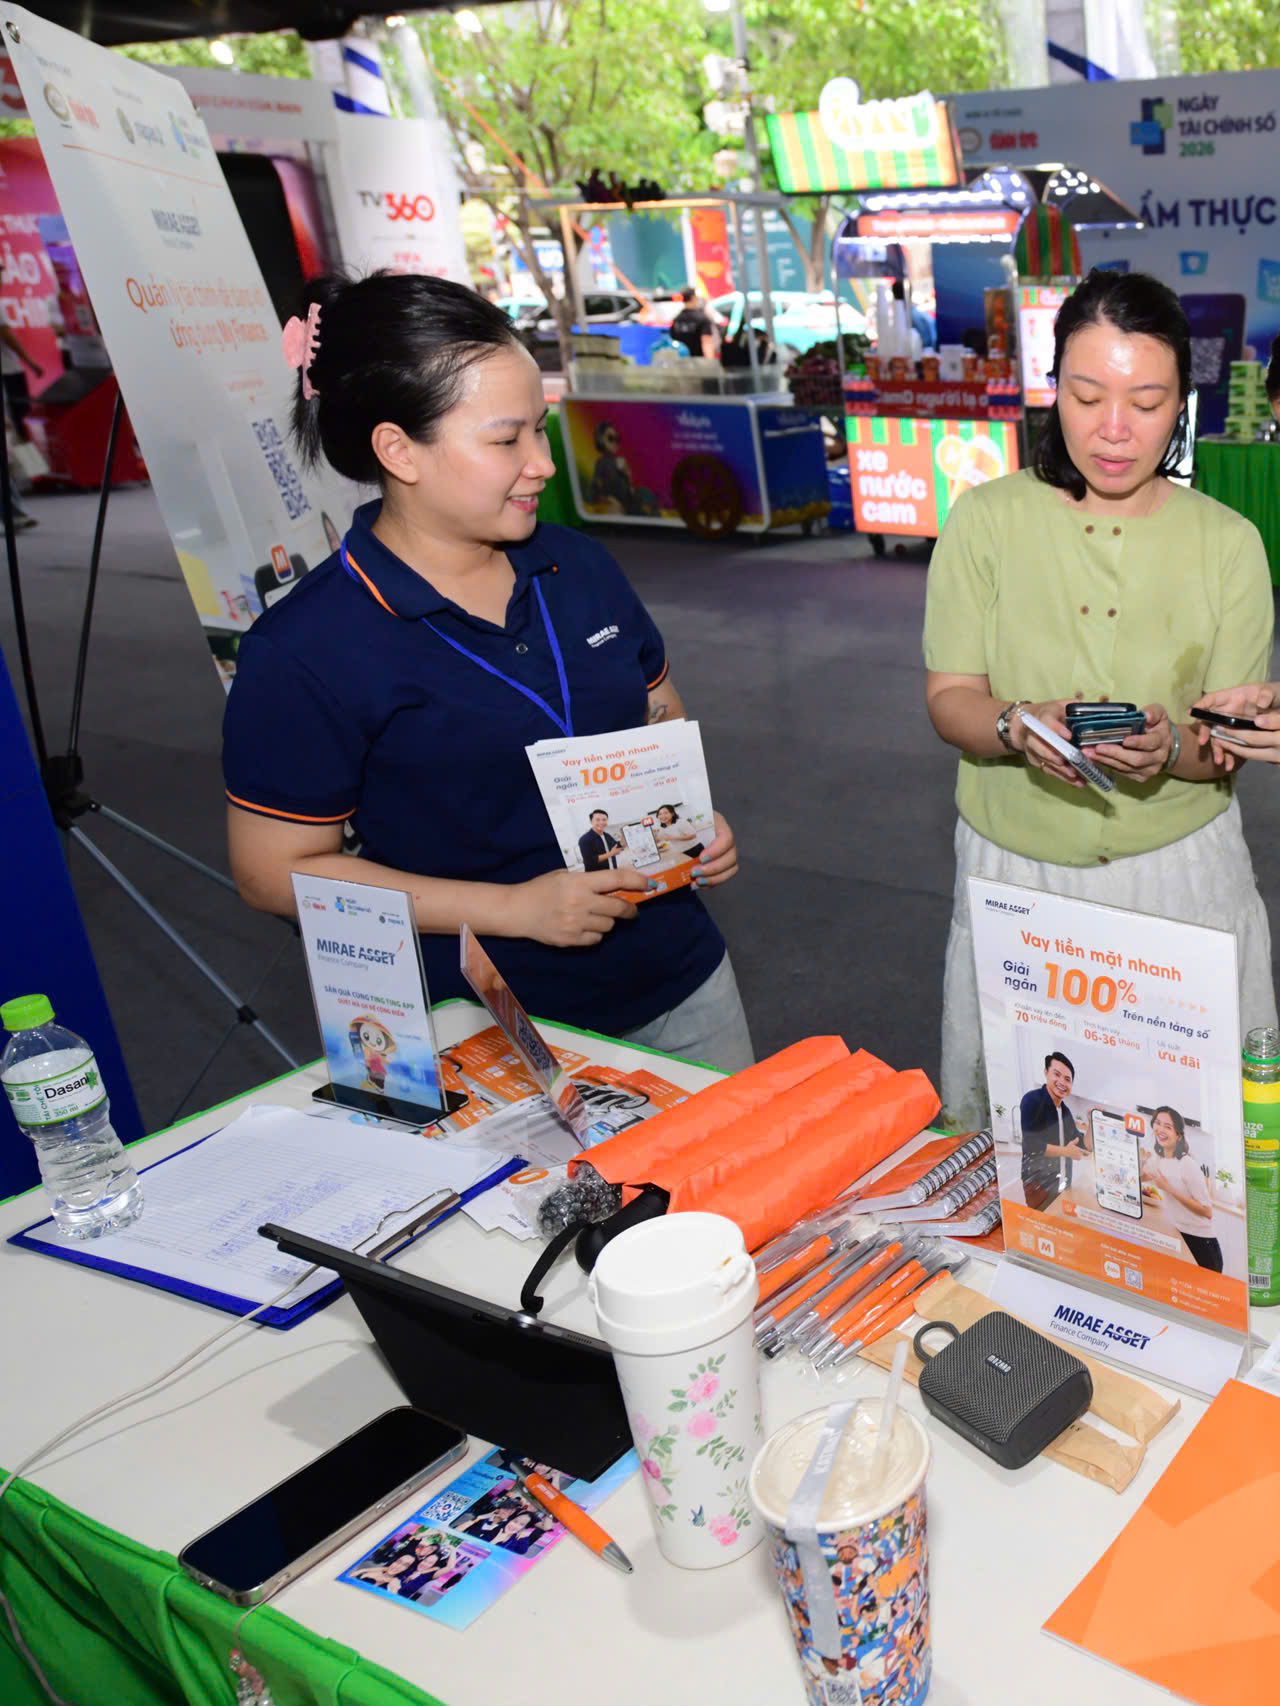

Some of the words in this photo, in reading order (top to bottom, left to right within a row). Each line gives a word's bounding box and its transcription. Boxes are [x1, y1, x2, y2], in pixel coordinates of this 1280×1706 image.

[1177, 93, 1219, 112] NGÀY
[1178, 117, 1201, 136] TÀI
[1203, 115, 1251, 136] CHÍNH
[1254, 108, 1277, 133] SỐ
[358, 190, 435, 222] TV360
[1188, 195, 1277, 235] THỰC
[856, 449, 888, 473] xe
[858, 471, 928, 500] nước
[861, 502, 917, 526] cam
[579, 760, 639, 787] 100%
[985, 898, 1008, 911] MIRAE
[316, 938, 356, 959] MIRAE
[358, 947, 396, 966] ASSET
[1020, 930, 1050, 953] Vay
[1055, 937, 1085, 959] tiền
[1090, 950, 1123, 970] mặt
[1128, 958, 1182, 982] nhanh
[1002, 960, 1030, 976] Giải
[1004, 976, 1038, 993] ngân
[1045, 961, 1138, 1013] 100%
[1015, 1010, 1029, 1023] 70
[1122, 1009, 1144, 1023] Trên
[1147, 1016, 1166, 1029] nền
[1169, 1021, 1194, 1038] tảng
[1196, 1029, 1211, 1039] số
[1084, 1028, 1117, 1047] 06-36
[1158, 1050, 1176, 1063] ưu
[1180, 1055, 1200, 1069] đãi
[1127, 1116, 1142, 1131] M
[1049, 1320, 1077, 1337] Finance
[1077, 1331, 1110, 1351] Company
[1054, 1304, 1104, 1334] MIRAE
[1101, 1323, 1151, 1350] ASSET
